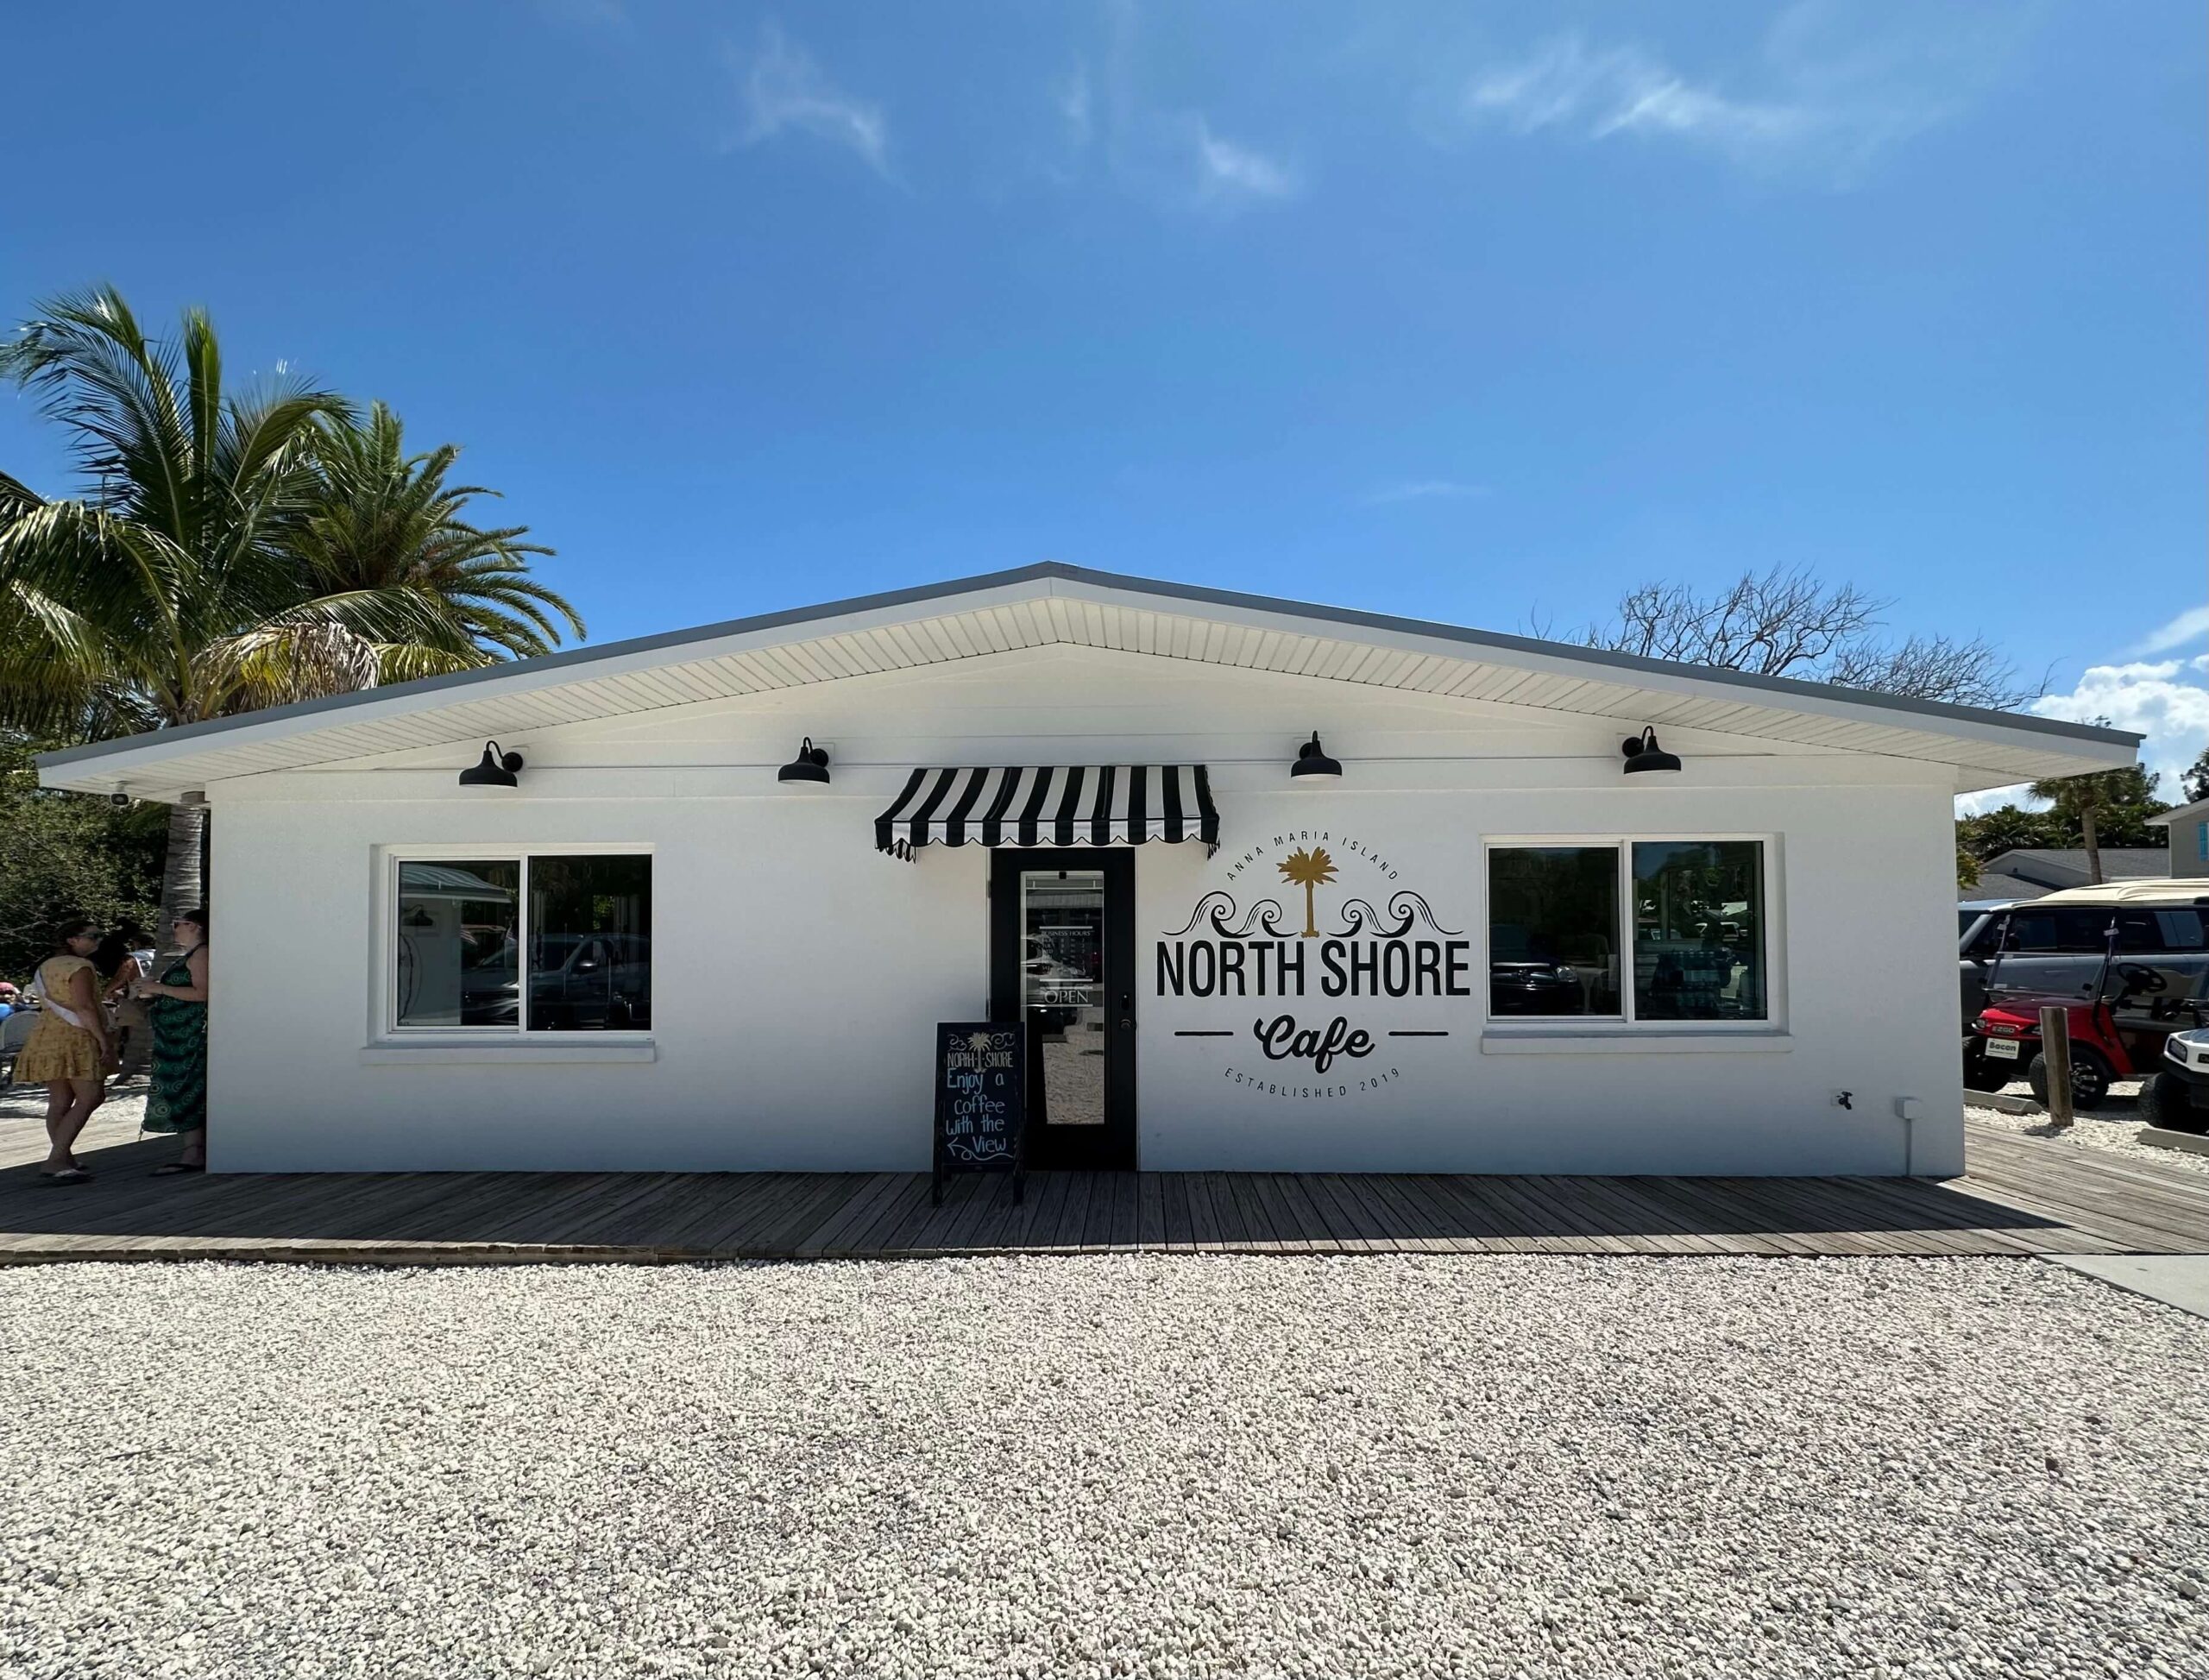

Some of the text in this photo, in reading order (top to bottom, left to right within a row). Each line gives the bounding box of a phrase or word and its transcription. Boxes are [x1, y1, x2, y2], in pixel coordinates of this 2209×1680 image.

[1226, 830, 1398, 881] ANNA MARIA ISLAND
[1156, 939, 1470, 997] NORTH SHORE
[1044, 990, 1089, 1004] OPEN
[1253, 1014, 1375, 1073] Cafe
[1989, 1041, 2017, 1052] Bacon
[947, 1050, 1014, 1068] NORTH SHORE
[947, 1067, 1005, 1095] Enjoy a
[1224, 1067, 1400, 1098] ESTABLISHED 2019
[980, 1113, 1005, 1133] the
[972, 1136, 1006, 1154] View
